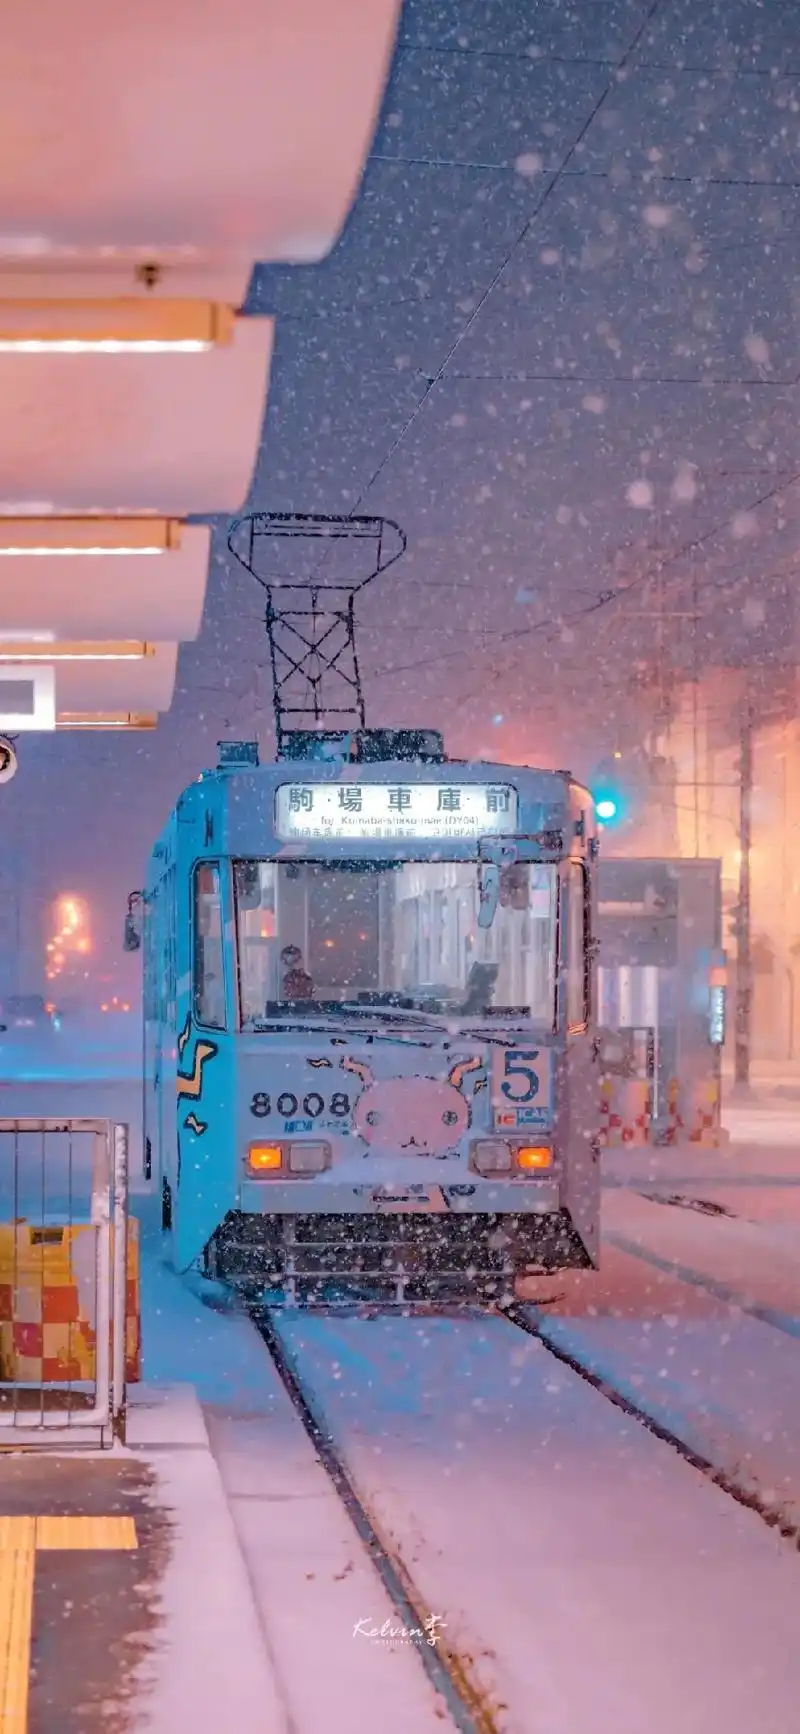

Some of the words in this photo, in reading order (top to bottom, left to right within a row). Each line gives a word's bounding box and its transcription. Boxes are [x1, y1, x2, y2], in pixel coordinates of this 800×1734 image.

[288, 787, 511, 813] 駒場車庫前
[501, 1051, 540, 1103] 5
[250, 1092, 351, 1118] 8008
